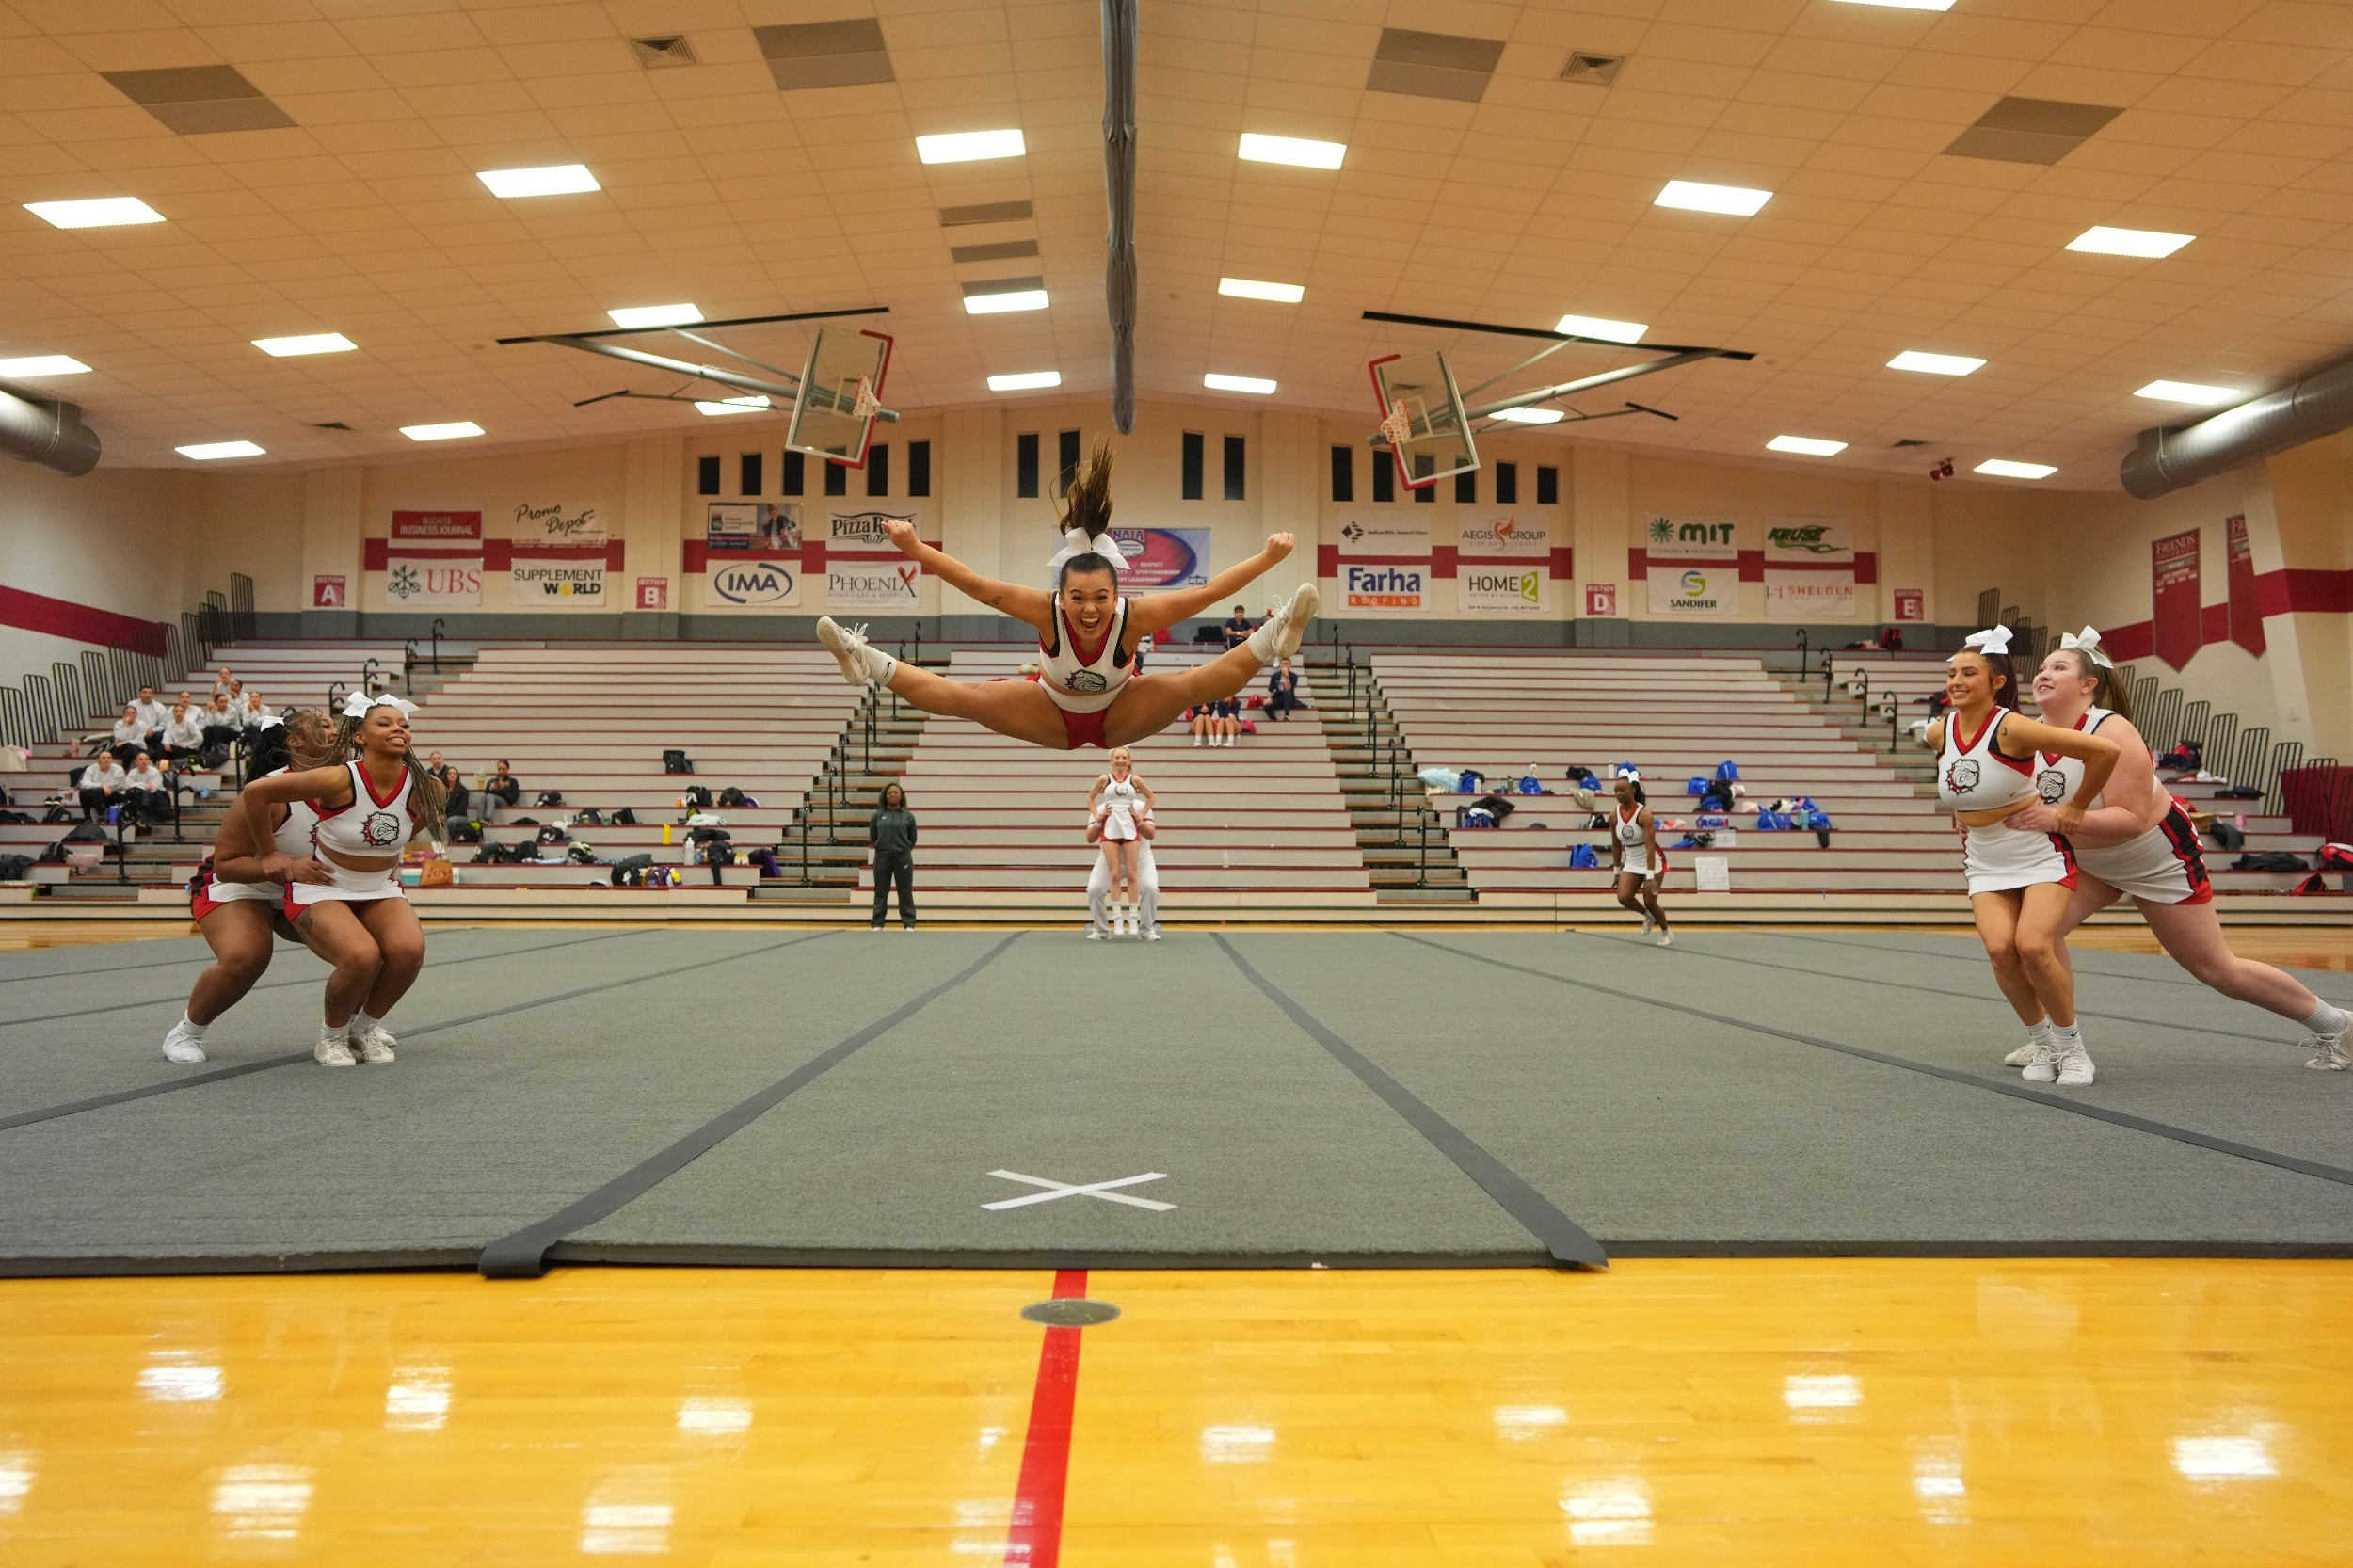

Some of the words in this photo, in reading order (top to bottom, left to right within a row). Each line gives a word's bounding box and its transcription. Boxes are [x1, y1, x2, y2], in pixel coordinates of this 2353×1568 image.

[422, 517, 451, 525] WICHITA
[513, 504, 562, 523] Promo
[400, 525, 438, 535] BUSINESS
[440, 525, 472, 535] JOURNAL
[545, 509, 595, 537] Depot
[832, 519, 871, 536] Pizza
[1112, 529, 1144, 542] NAIA
[1462, 530, 1494, 539] AEGIS
[1509, 530, 1546, 540] GROUP
[426, 568, 481, 594] UBS
[513, 569, 603, 581] SUPPLEMENT
[728, 573, 780, 592] IMA
[828, 566, 918, 598] PHOENIX
[1348, 567, 1421, 592] Farha
[1469, 576, 1519, 592] HOME
[1788, 585, 1853, 596] SHELDEN
[321, 584, 337, 602] A
[645, 586, 660, 605] B
[1350, 596, 1417, 605] ROOFING
[1594, 593, 1609, 612] D
[1670, 599, 1717, 608] SANDIFER
[1904, 599, 1916, 616] E
